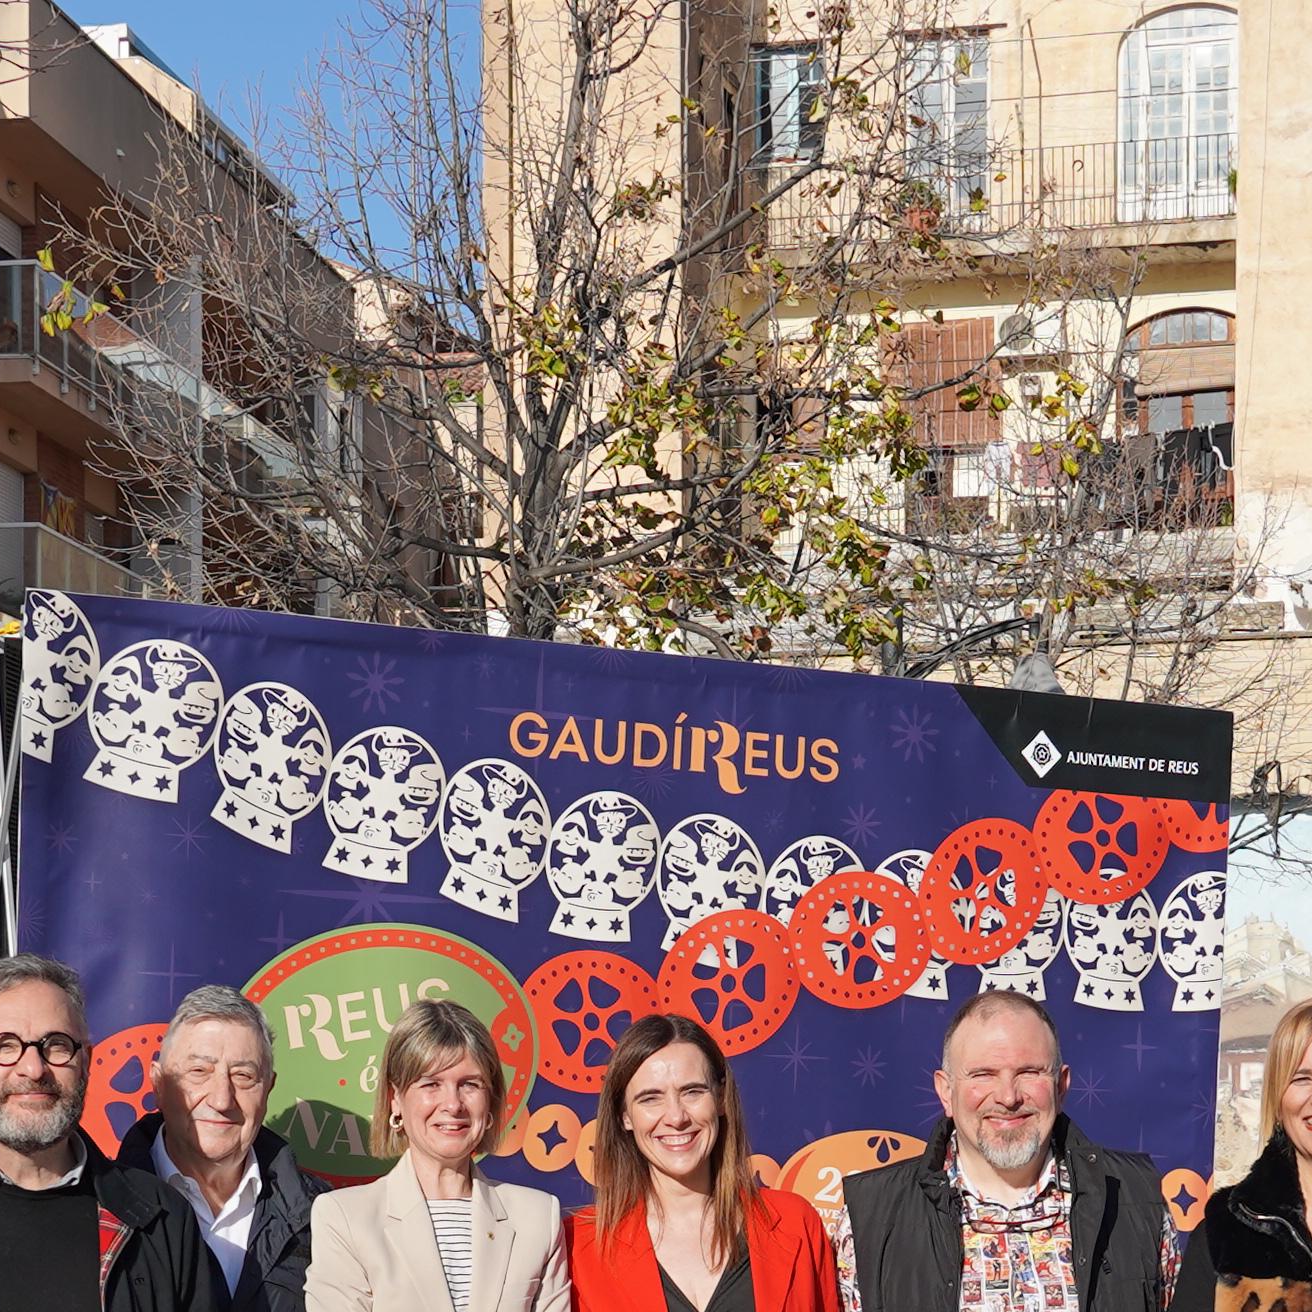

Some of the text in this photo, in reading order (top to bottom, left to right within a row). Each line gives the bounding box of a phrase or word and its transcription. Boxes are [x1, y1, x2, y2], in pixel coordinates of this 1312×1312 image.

[1066, 750, 1199, 776] AJUNTAMENT DE REUS
[282, 1096, 372, 1157] NA
